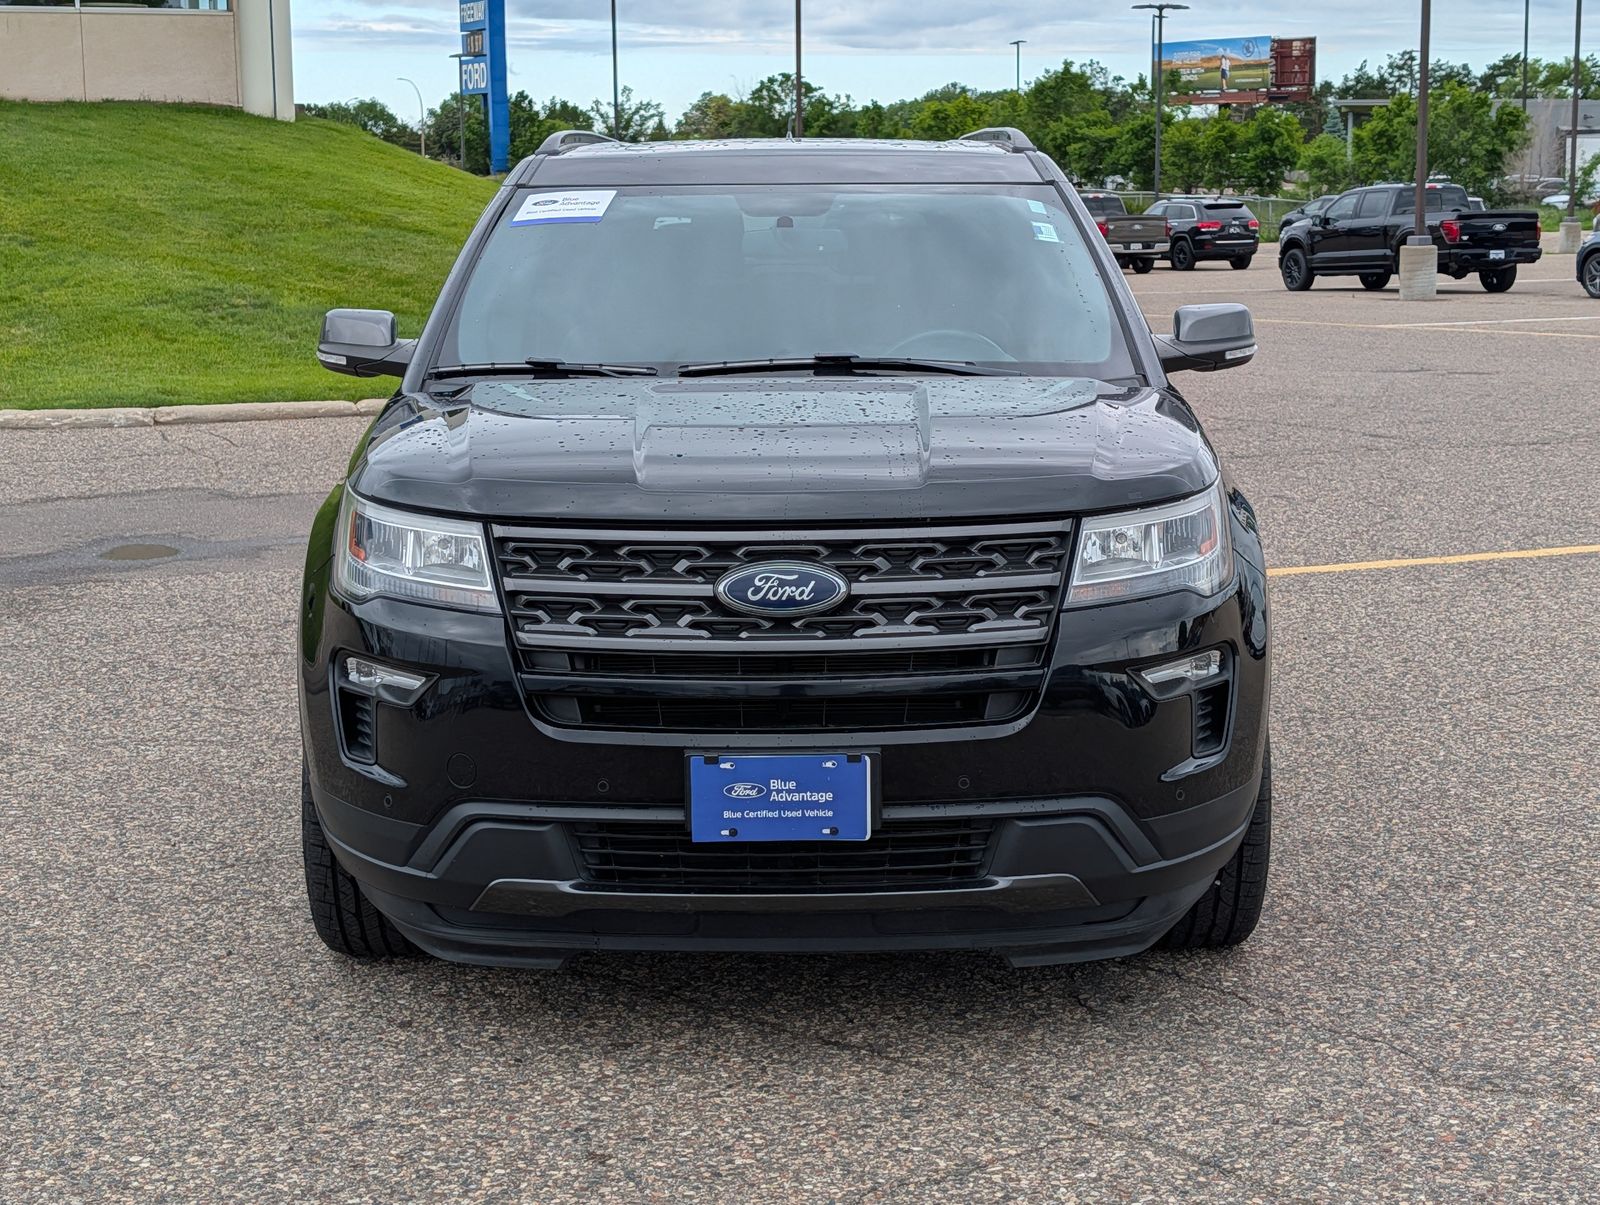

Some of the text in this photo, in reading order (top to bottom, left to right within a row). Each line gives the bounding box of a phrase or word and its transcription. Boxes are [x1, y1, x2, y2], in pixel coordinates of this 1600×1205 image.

[462, 63, 487, 90] FORD
[747, 573, 816, 601] Ford
[731, 784, 759, 797] Ford
[770, 779, 797, 790] Blue
[769, 791, 834, 803] Advantage
[723, 809, 834, 819] Blue Certified Used Vehicle
